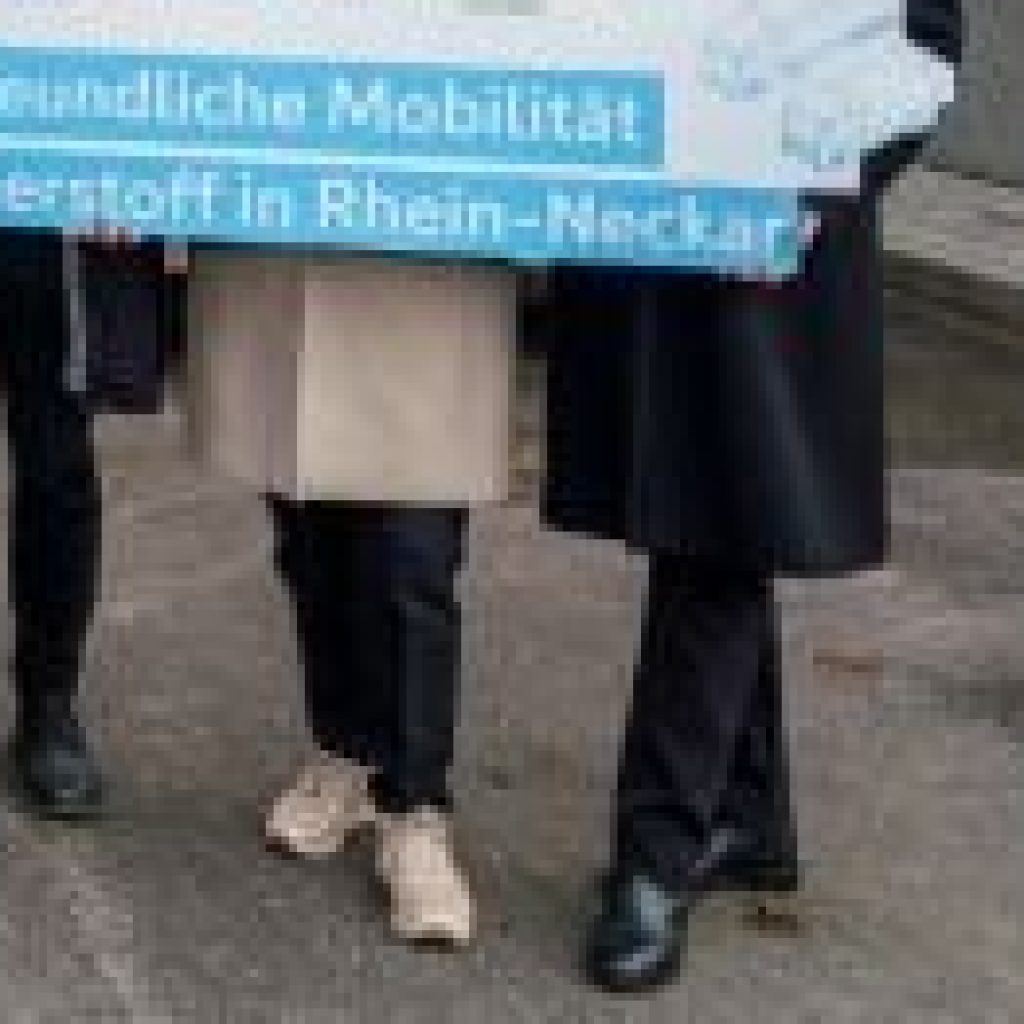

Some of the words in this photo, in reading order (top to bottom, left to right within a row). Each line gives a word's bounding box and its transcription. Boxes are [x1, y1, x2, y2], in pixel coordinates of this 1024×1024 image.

[328, 74, 637, 144] Mobilität
[238, 170, 291, 228] in
[319, 177, 798, 256] Rhein-Neckar
